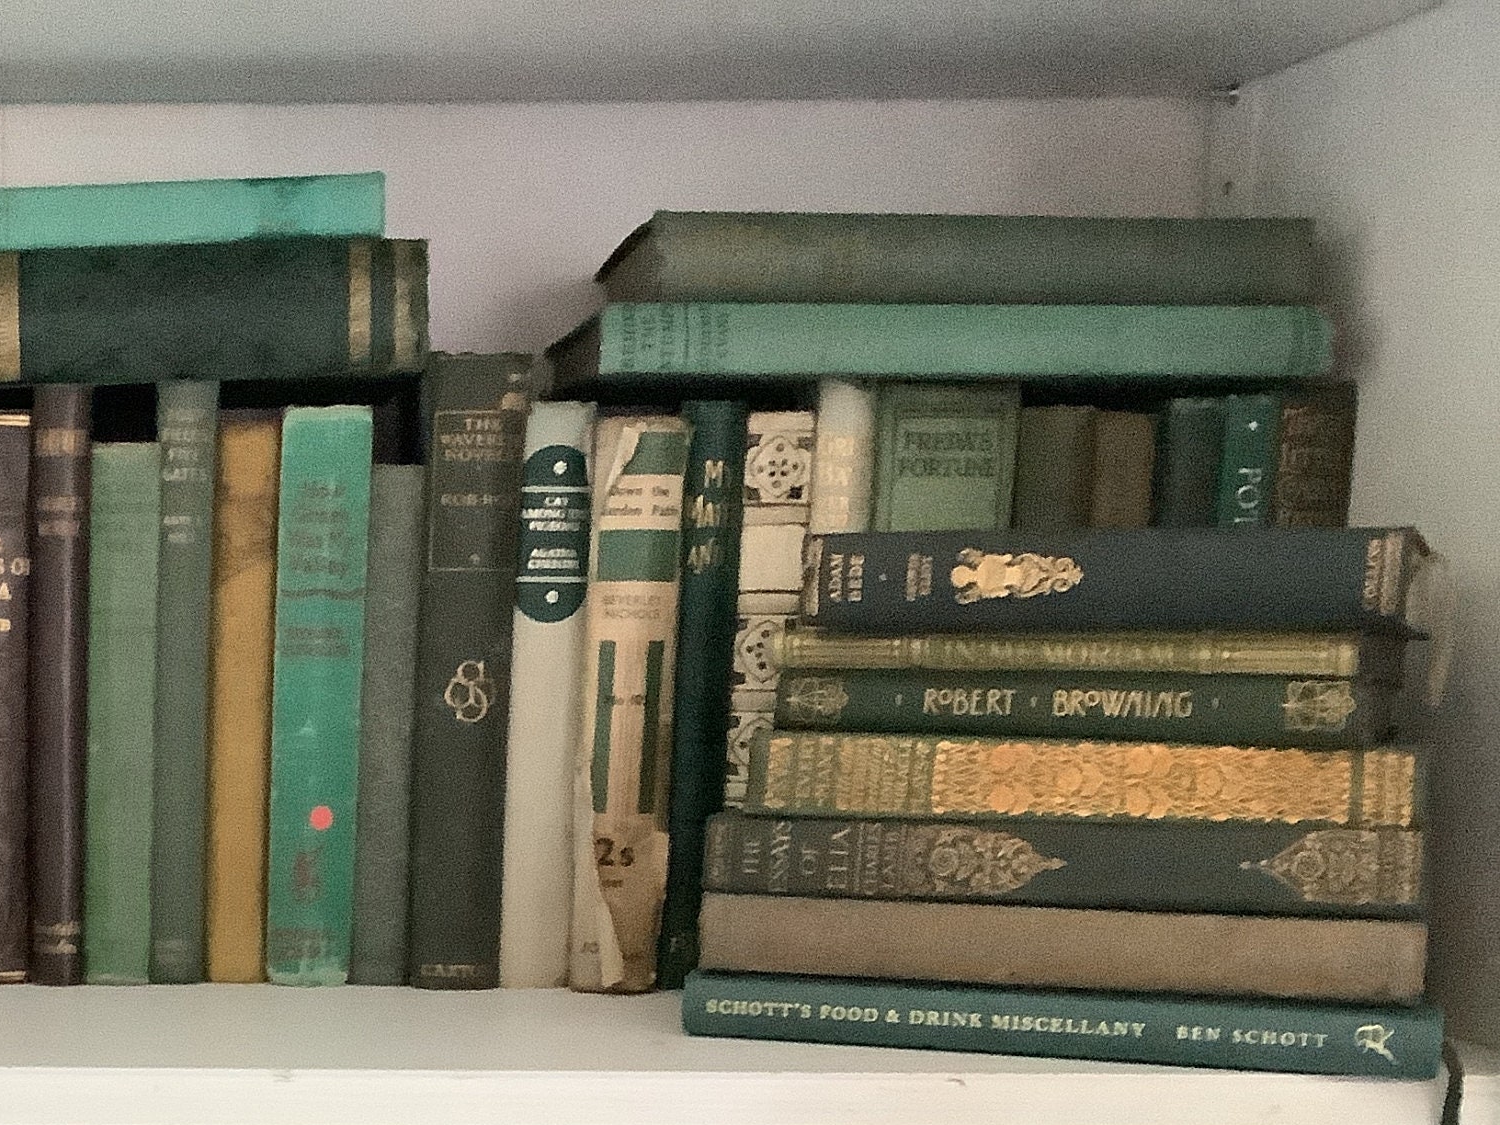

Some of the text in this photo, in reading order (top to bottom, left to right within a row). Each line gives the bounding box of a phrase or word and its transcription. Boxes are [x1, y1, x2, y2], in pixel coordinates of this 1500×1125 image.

[846, 553, 866, 604] BEDE
[921, 686, 1195, 720] ROBERT BROWNING
[825, 826, 852, 890] ELIA
[705, 997, 1329, 1049] SCHOTT'S FOOD & DRINK MISCELLANY BEN SCHOTT
